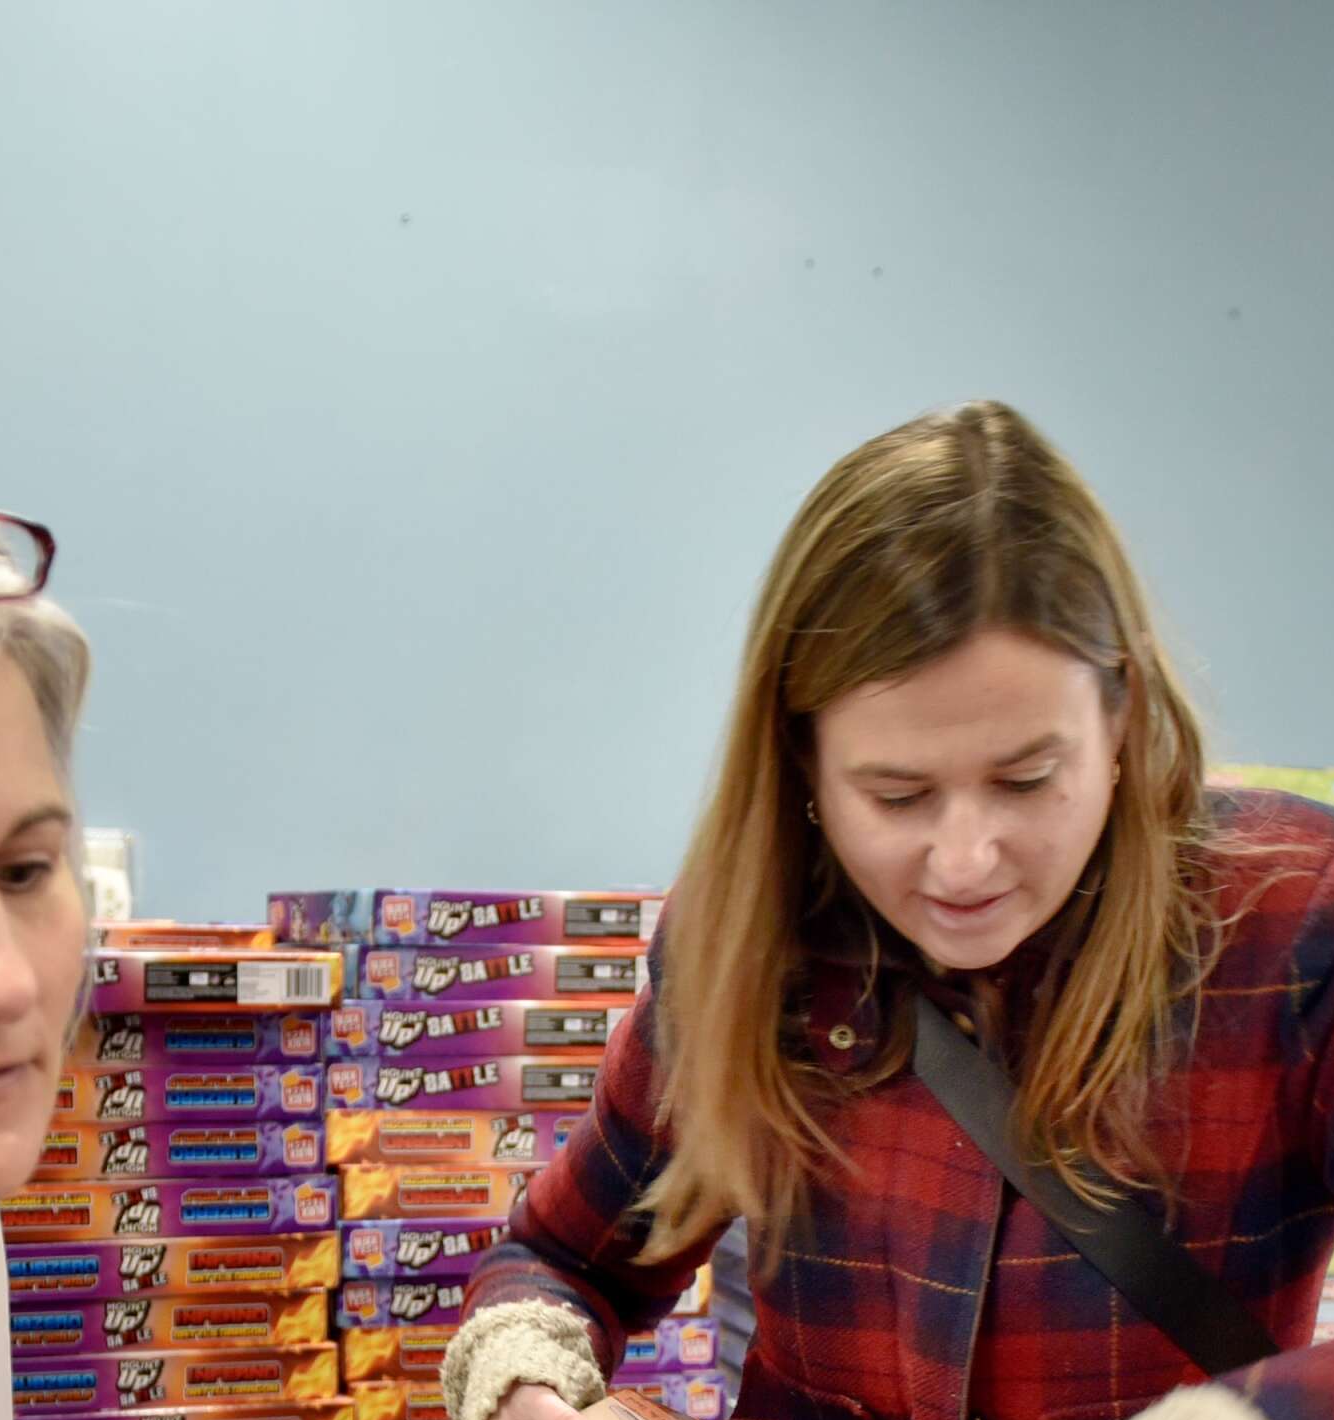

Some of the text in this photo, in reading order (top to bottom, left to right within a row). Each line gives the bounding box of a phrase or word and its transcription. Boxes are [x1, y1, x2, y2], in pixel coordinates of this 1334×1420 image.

[472, 897, 543, 927] BATTLE
[459, 953, 533, 983] BATTLE
[427, 1007, 501, 1037] BATTLE
[424, 1062, 499, 1094] BATTLE
